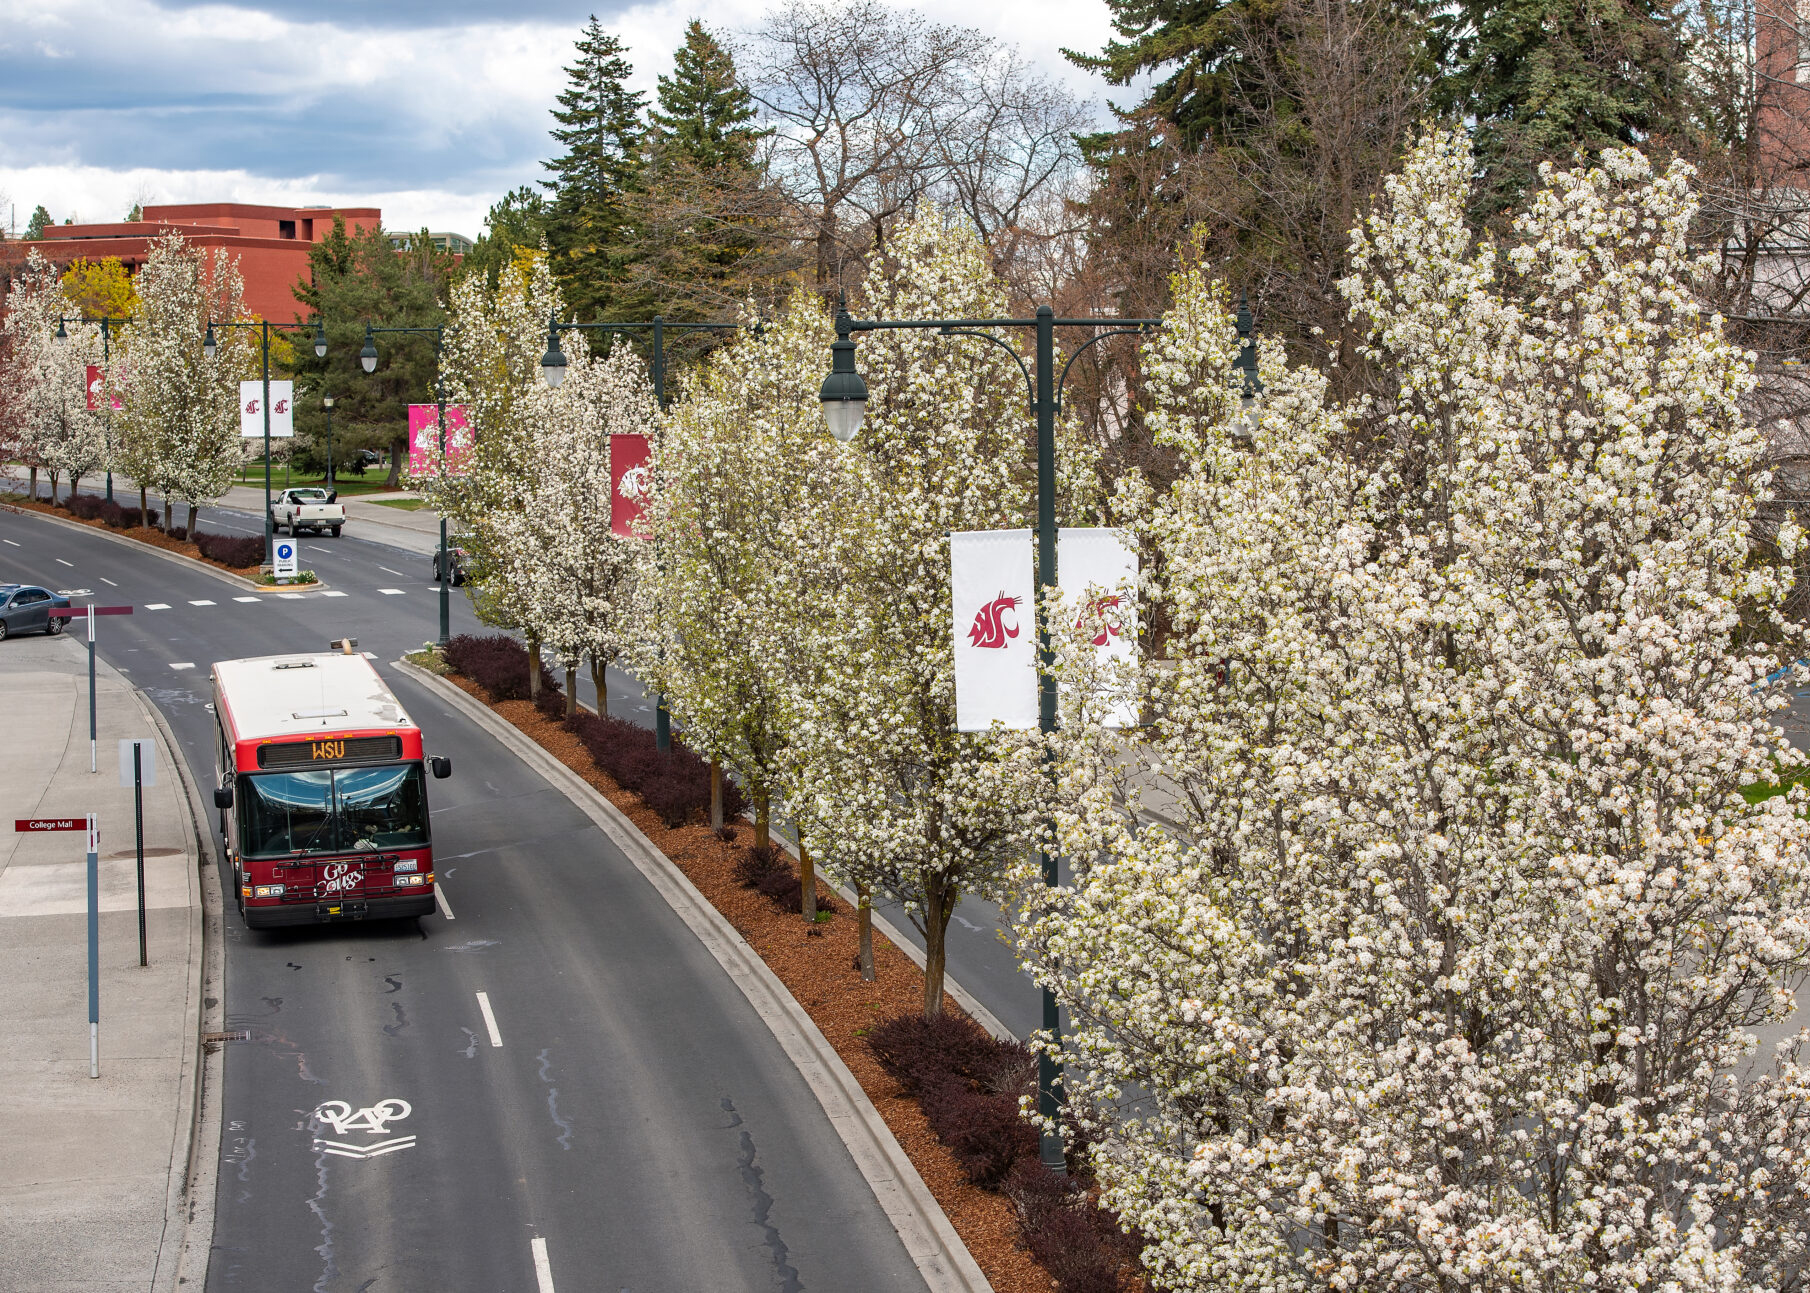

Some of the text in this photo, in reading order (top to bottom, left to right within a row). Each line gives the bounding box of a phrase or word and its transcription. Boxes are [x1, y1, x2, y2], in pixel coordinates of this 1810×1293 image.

[312, 741, 345, 760] WSU
[29, 820, 73, 830] College Mall
[323, 861, 348, 880] Go
